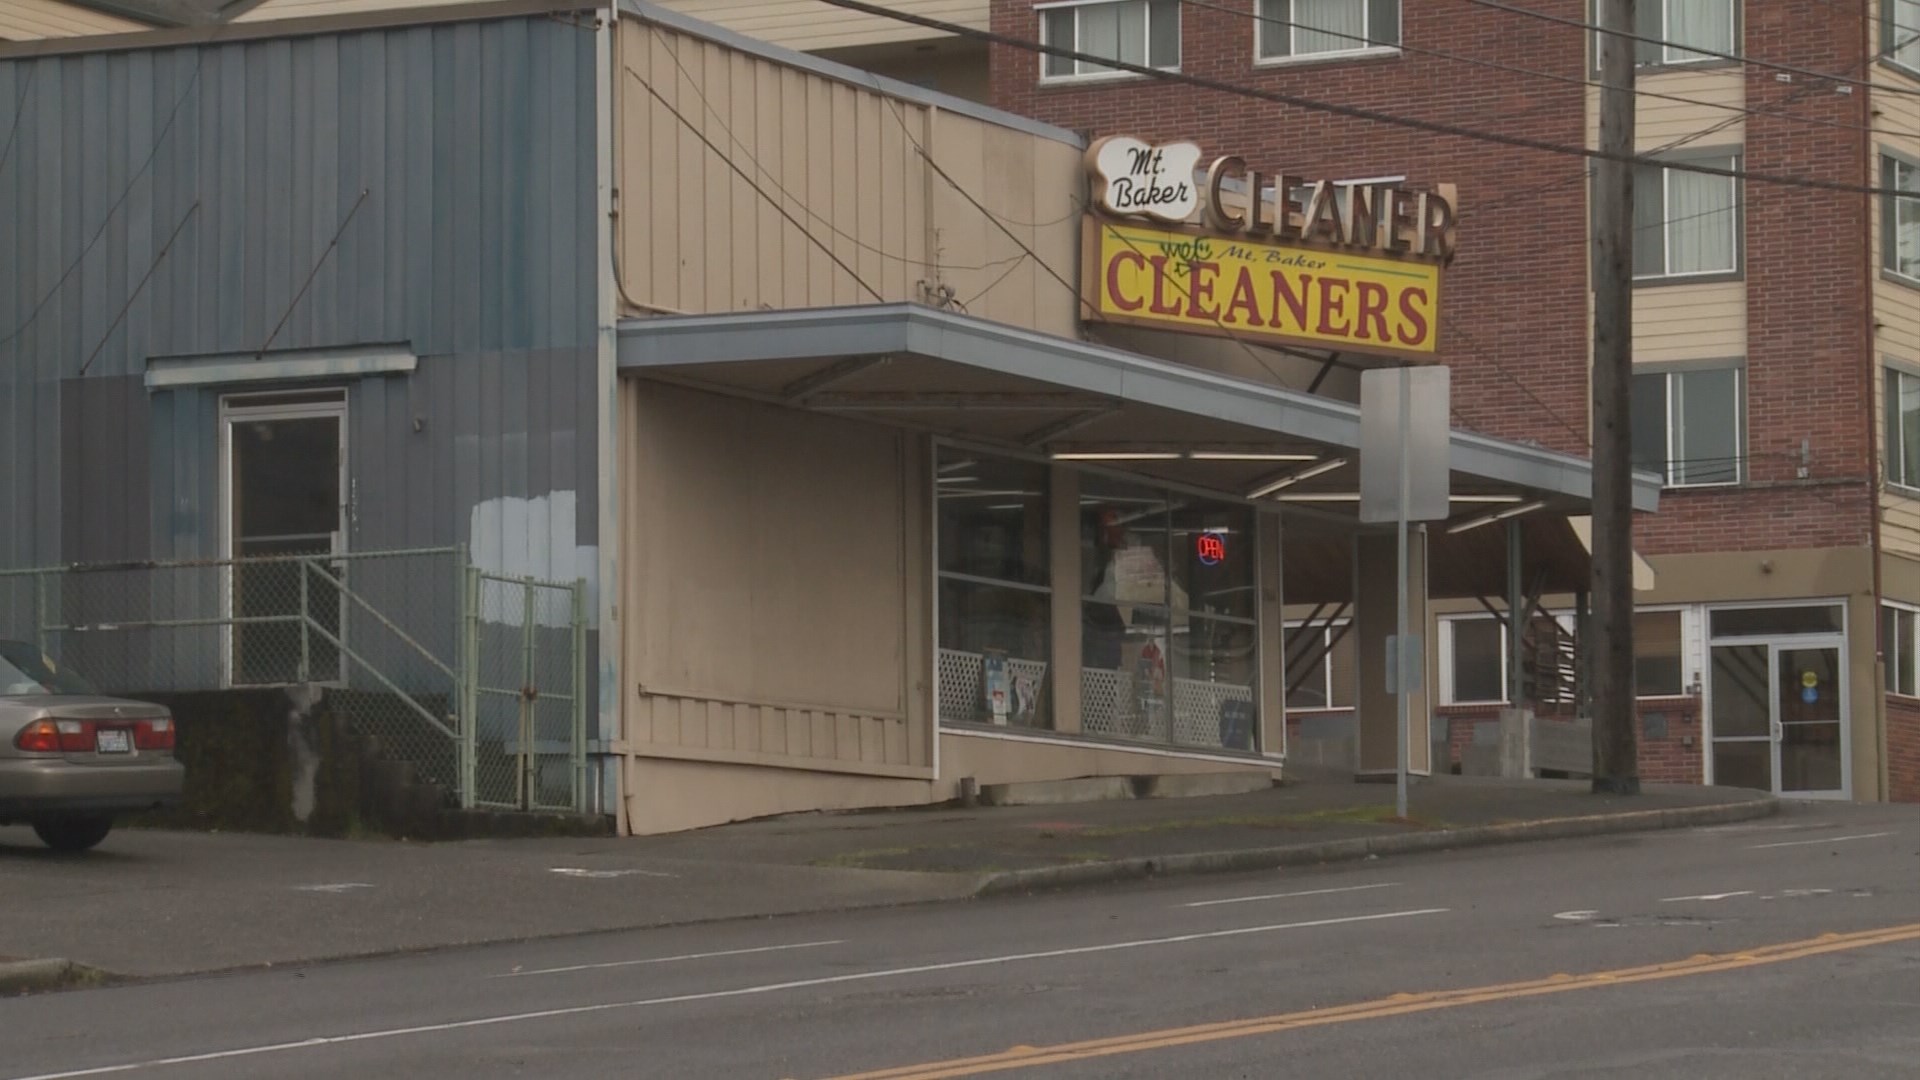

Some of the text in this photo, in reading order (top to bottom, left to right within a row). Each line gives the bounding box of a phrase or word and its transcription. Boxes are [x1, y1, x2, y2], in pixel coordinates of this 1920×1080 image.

[1127, 147, 1166, 174] Mt.
[1113, 177, 1189, 208] Baker
[1265, 250, 1326, 269] Baker
[1107, 250, 1428, 346] CLEANERS
[1198, 536, 1225, 561] OPEN
